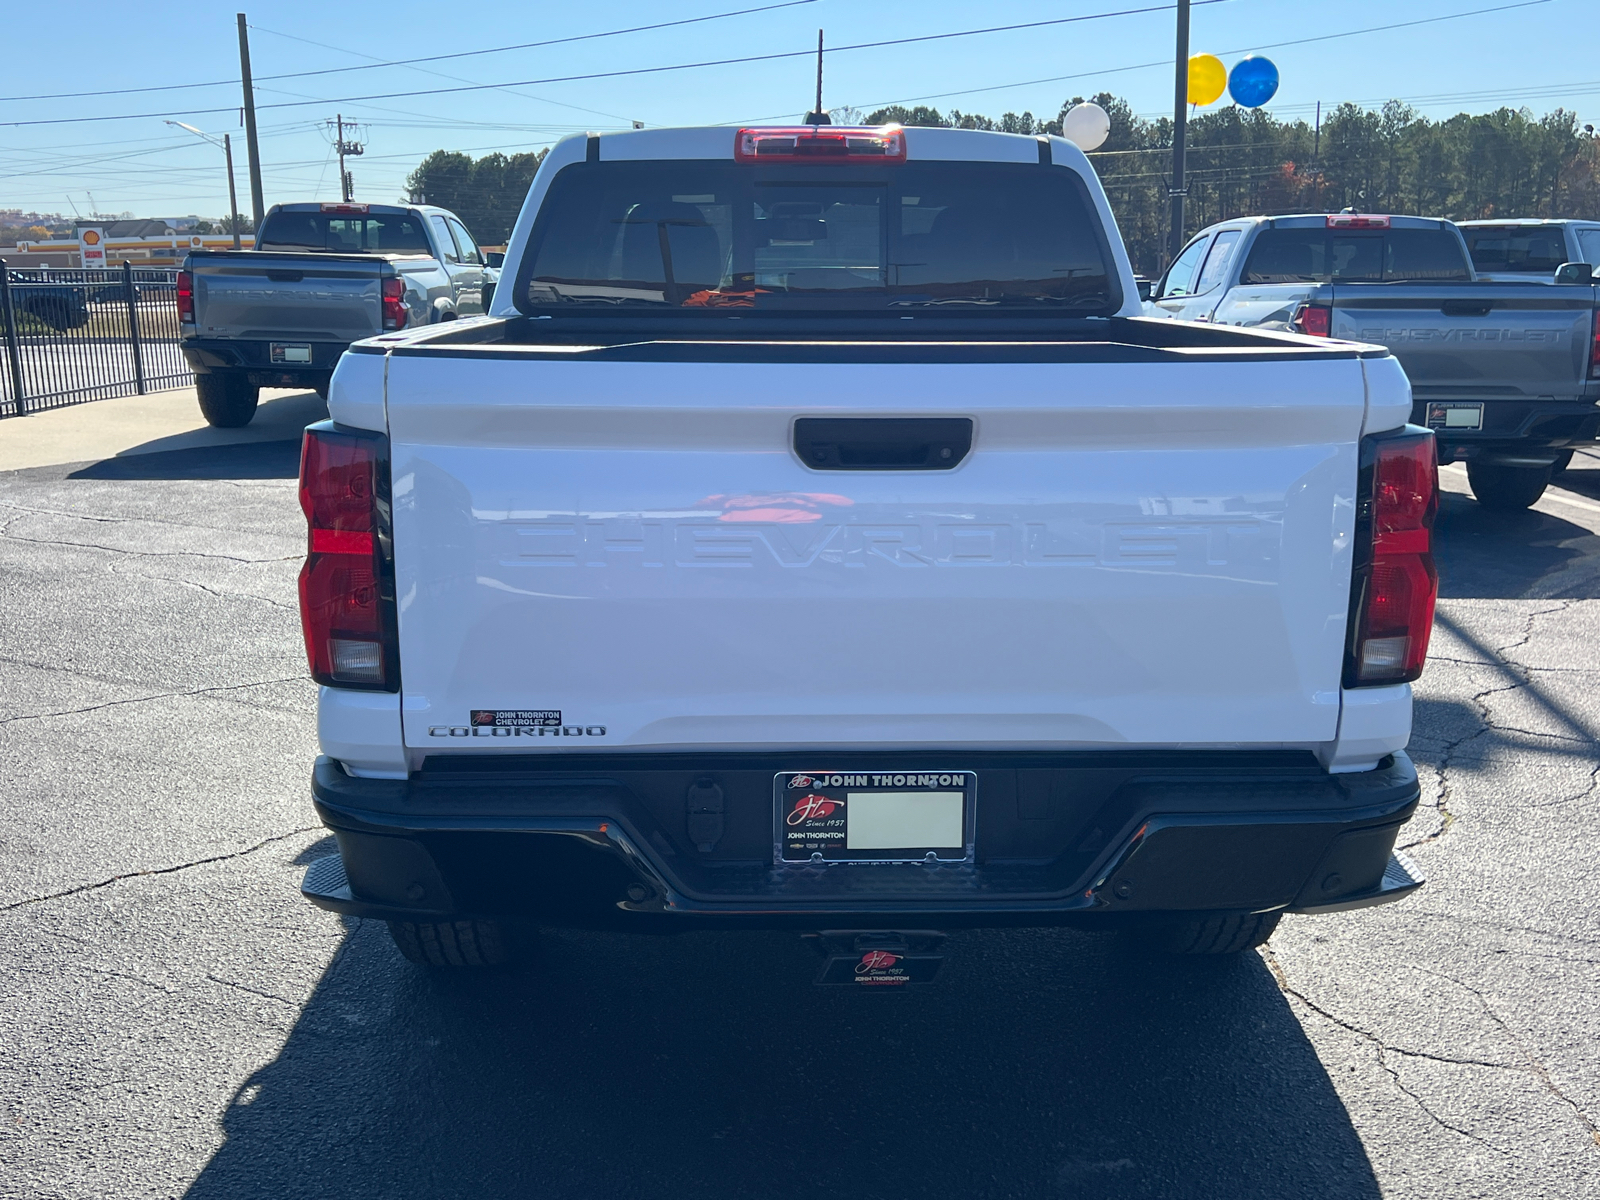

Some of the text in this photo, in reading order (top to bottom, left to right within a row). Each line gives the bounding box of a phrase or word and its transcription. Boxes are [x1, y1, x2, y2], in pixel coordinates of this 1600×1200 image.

[1361, 327, 1569, 343] CHEVROLET
[498, 520, 1261, 569] CHEVROLET
[495, 711, 516, 719] JOHN
[517, 711, 560, 719] THORNTON
[495, 718, 545, 726] CHEVROLET
[428, 725, 607, 738] COLORADO
[822, 774, 868, 787] JOHN
[872, 774, 965, 787] THORNTON
[805, 819, 845, 827] Since 1957
